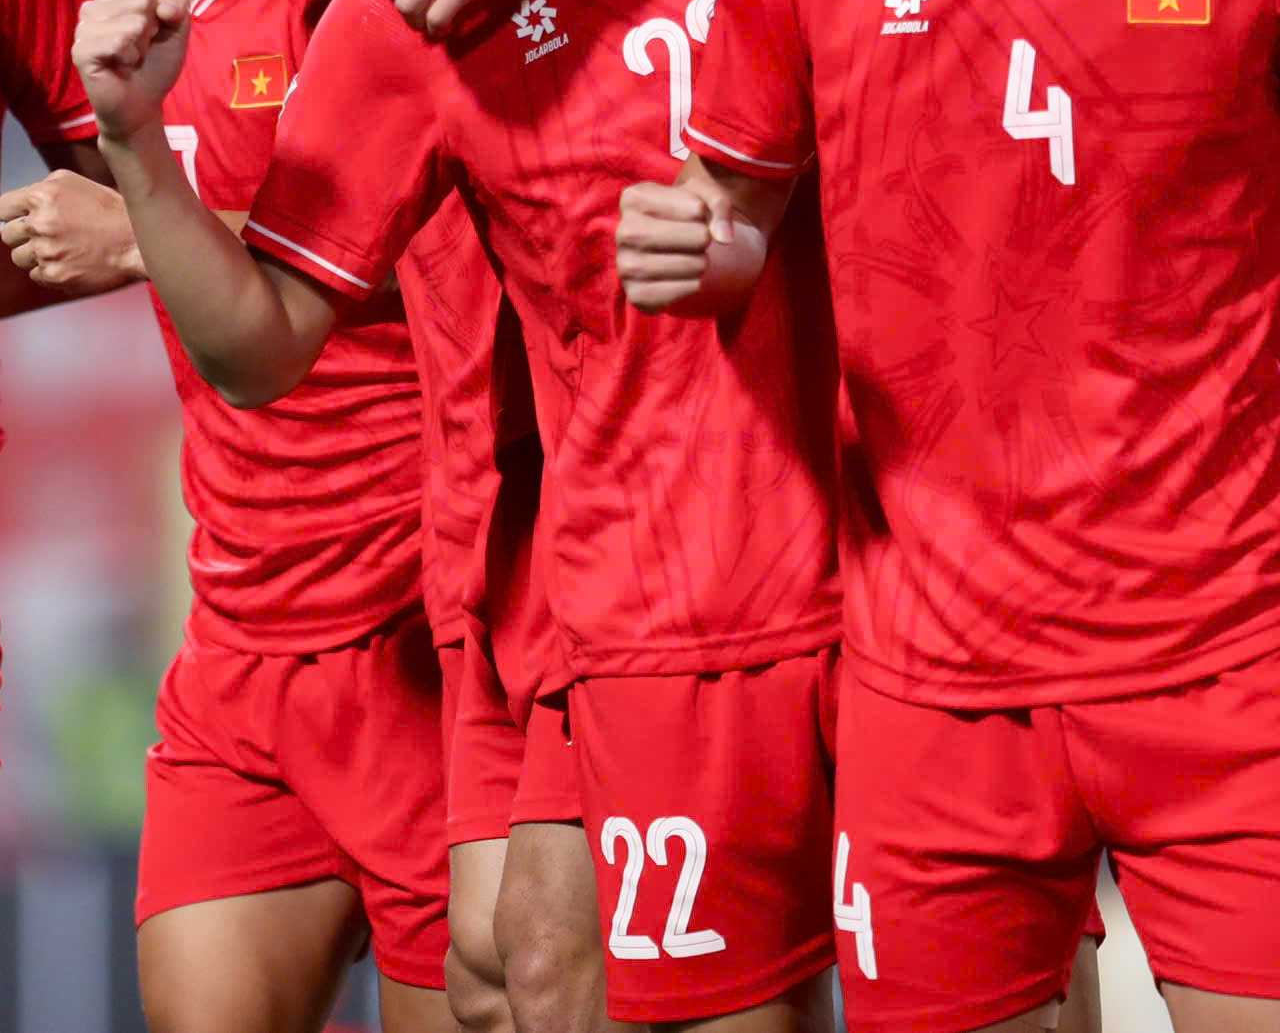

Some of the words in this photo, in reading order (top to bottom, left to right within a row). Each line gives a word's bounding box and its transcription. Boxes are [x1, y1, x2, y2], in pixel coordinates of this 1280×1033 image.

[1002, 39, 1076, 186] 4
[600, 815, 726, 960] 22
[833, 831, 878, 980] 4
